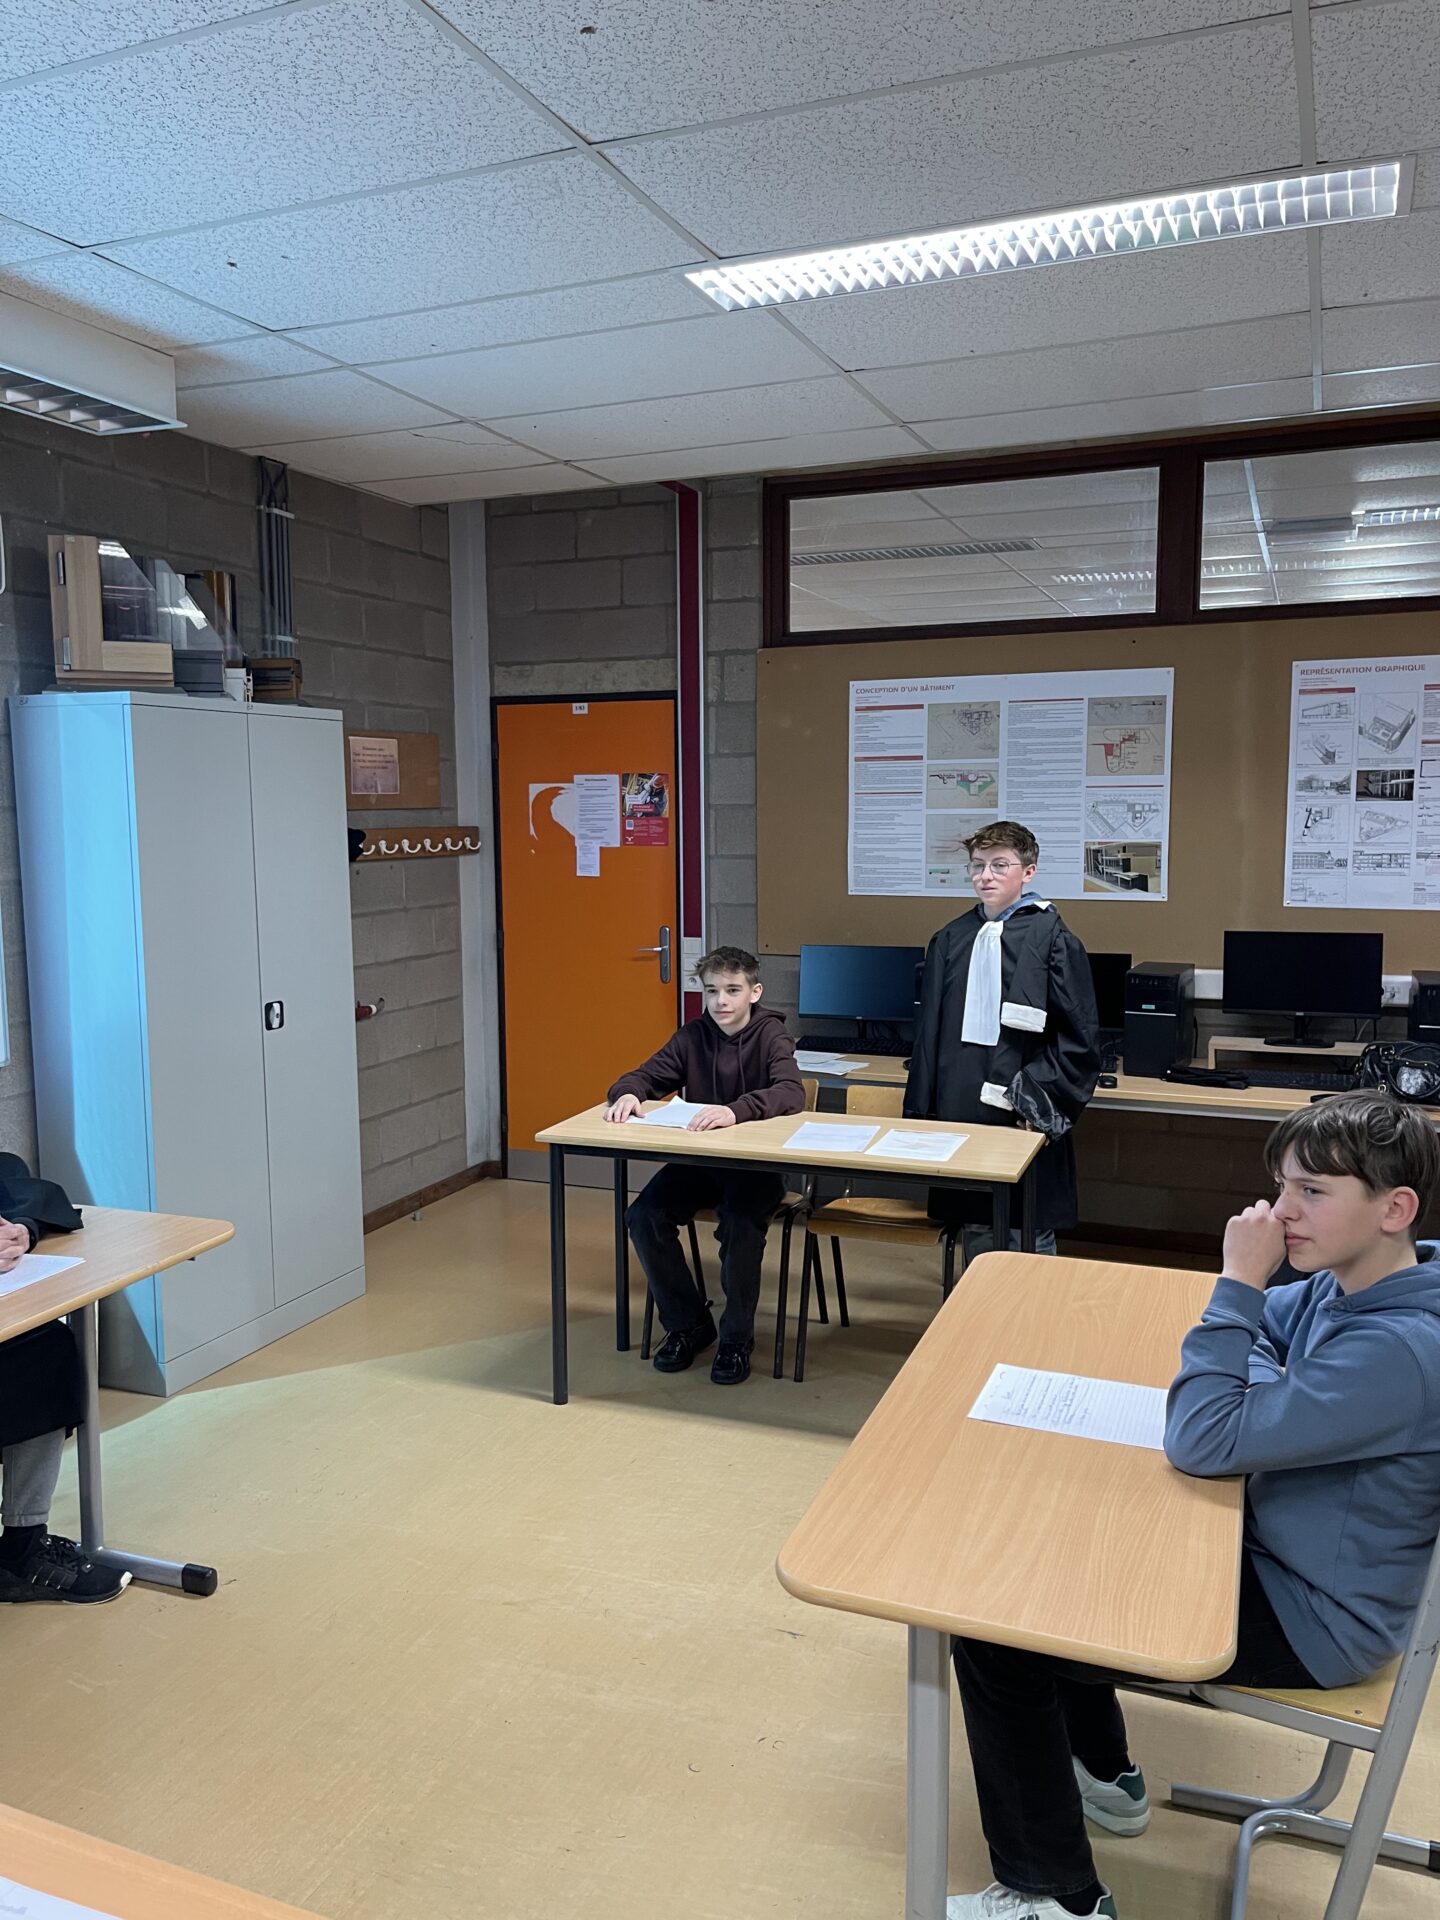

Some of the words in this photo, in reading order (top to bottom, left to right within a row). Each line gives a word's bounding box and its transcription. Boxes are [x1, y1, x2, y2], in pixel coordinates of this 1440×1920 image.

[1300, 666, 1372, 676] REPRÉSENTATION
[1375, 664, 1426, 673] GRAPHIQUE
[920, 684, 956, 692] BÂTIMENT
